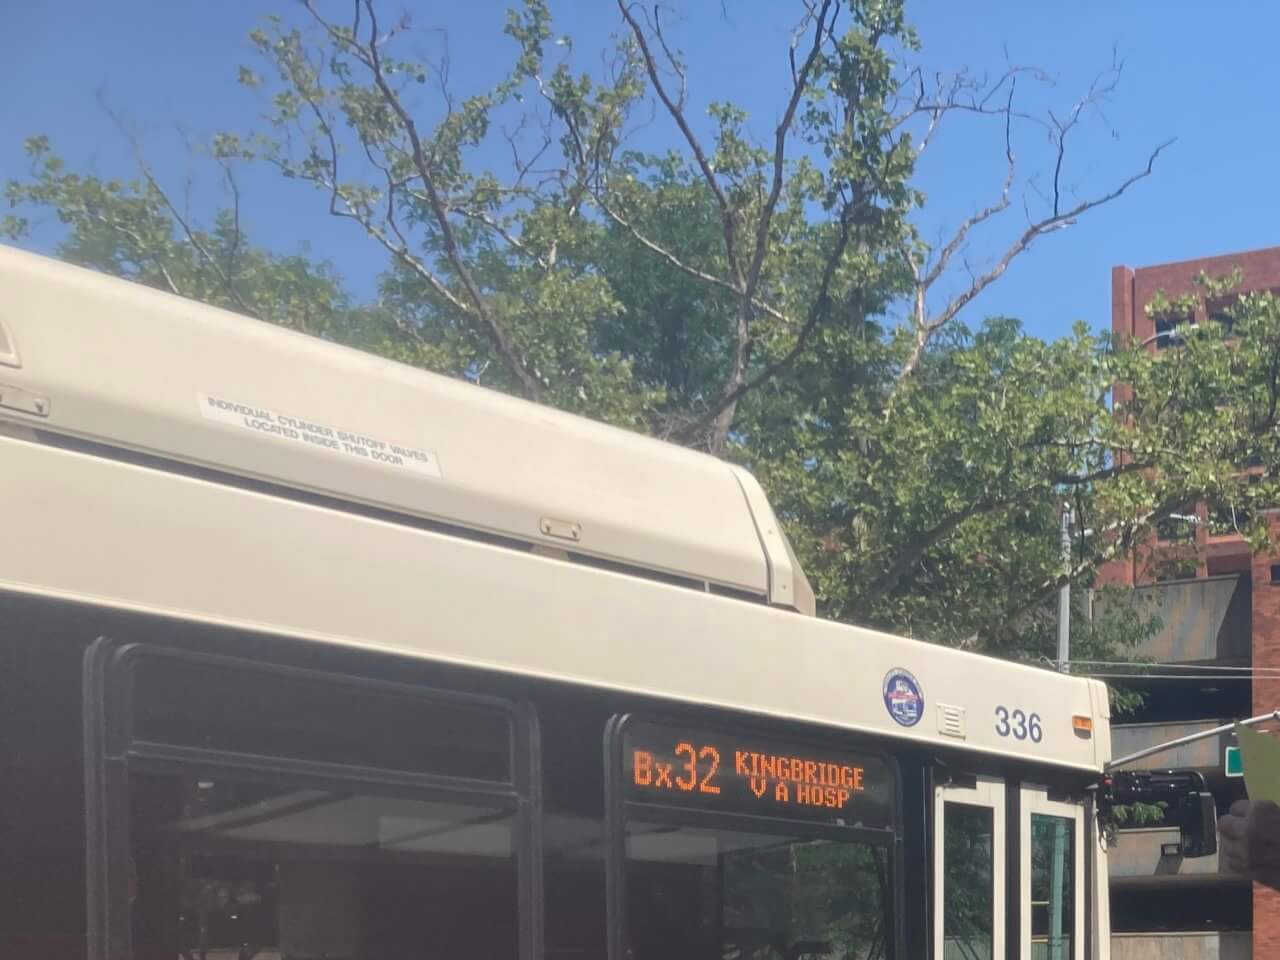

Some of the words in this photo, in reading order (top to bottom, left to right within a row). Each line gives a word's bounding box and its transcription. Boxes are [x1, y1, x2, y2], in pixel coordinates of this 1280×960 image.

[207, 396, 274, 422] INDIVIDUAL
[277, 414, 334, 438] CYLINDER
[336, 430, 387, 450] SHUTOFF
[389, 444, 429, 462] VALVES
[244, 417, 299, 440] LOCATED
[302, 432, 340, 451] INSIDE
[344, 442, 369, 458] THIS
[371, 449, 404, 466] DOOR
[994, 704, 1043, 744] 336
[633, 742, 721, 795] Bx32
[735, 750, 865, 791] KINGBRIDGE
[750, 778, 767, 799] V
[775, 781, 790, 803] A
[797, 785, 851, 809] HOSP
